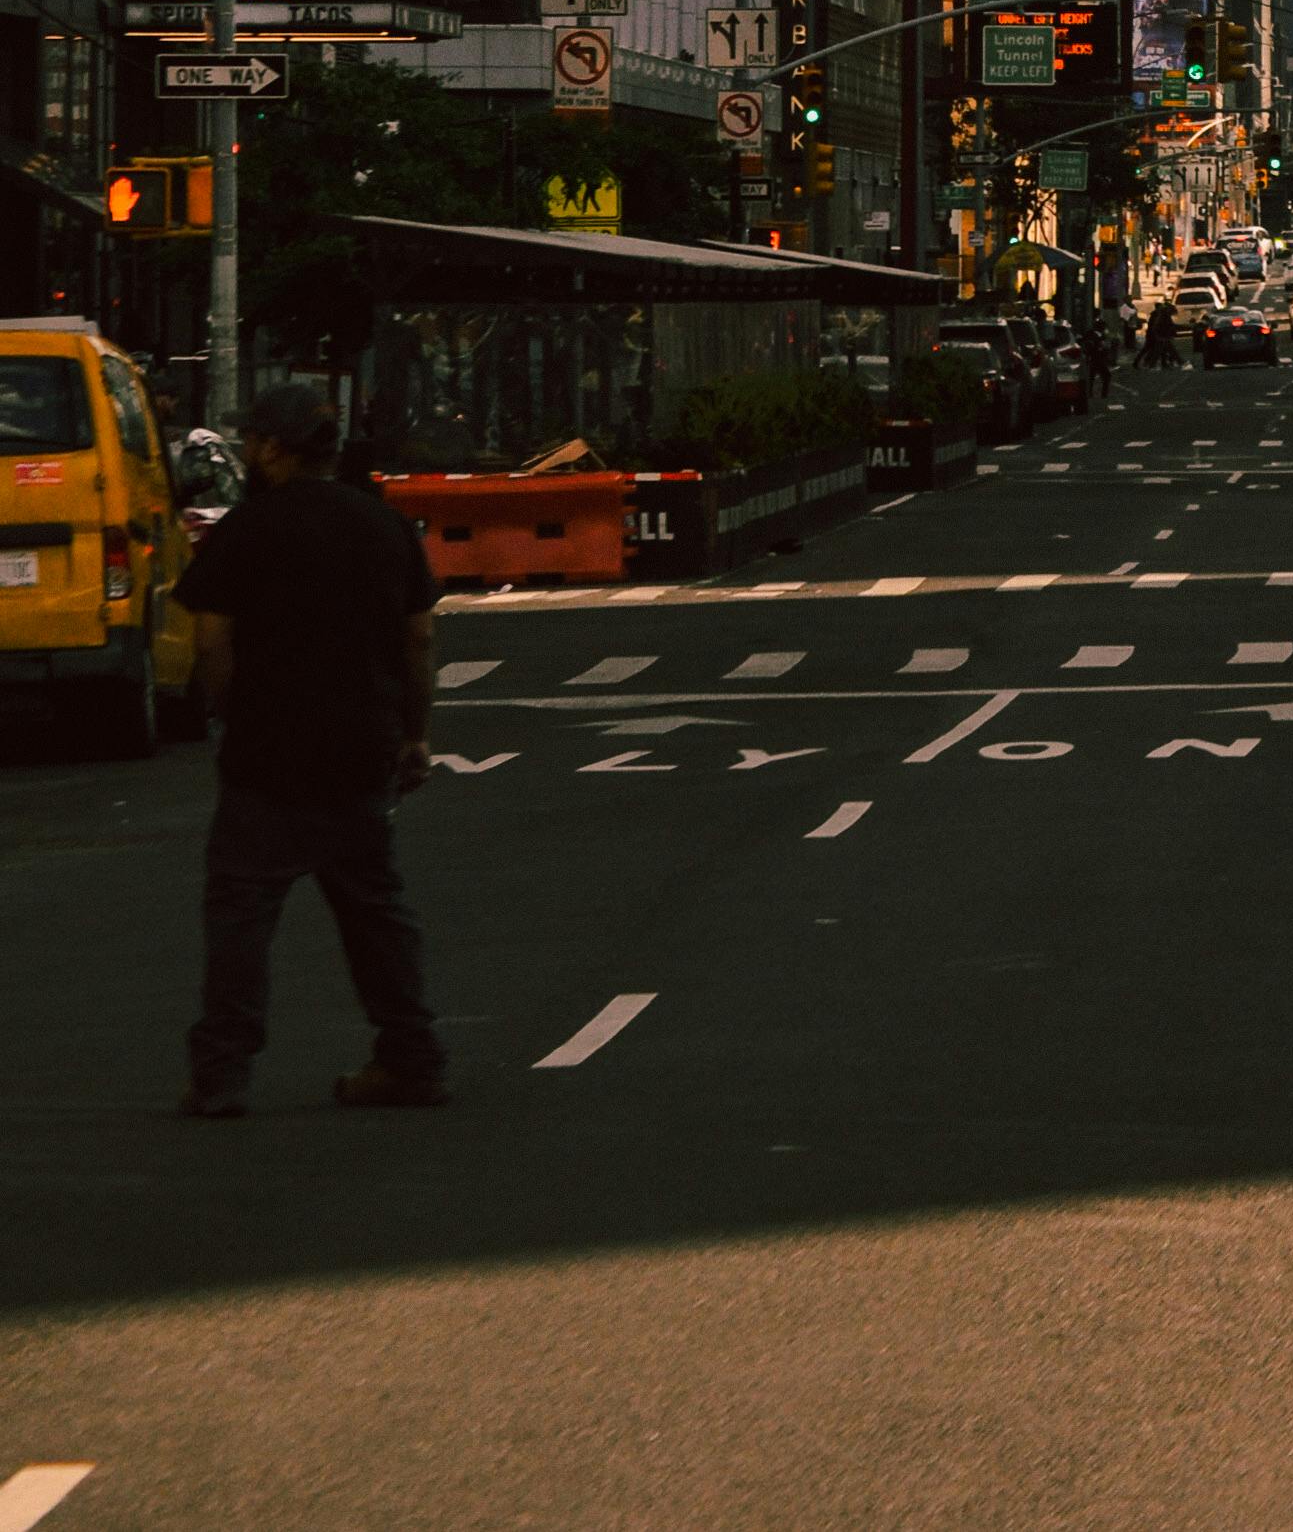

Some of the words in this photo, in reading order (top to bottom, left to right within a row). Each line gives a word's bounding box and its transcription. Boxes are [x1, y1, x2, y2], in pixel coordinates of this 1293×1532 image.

[288, 5, 353, 24] TACOS
[994, 34, 1045, 46] Lincoln
[747, 54, 774, 64] ONLY
[996, 49, 1043, 61] Tunnel
[176, 68, 213, 84] ONE
[229, 68, 270, 84] WAY
[989, 65, 1019, 77] KEEP
[1023, 65, 1049, 77] LEFT
